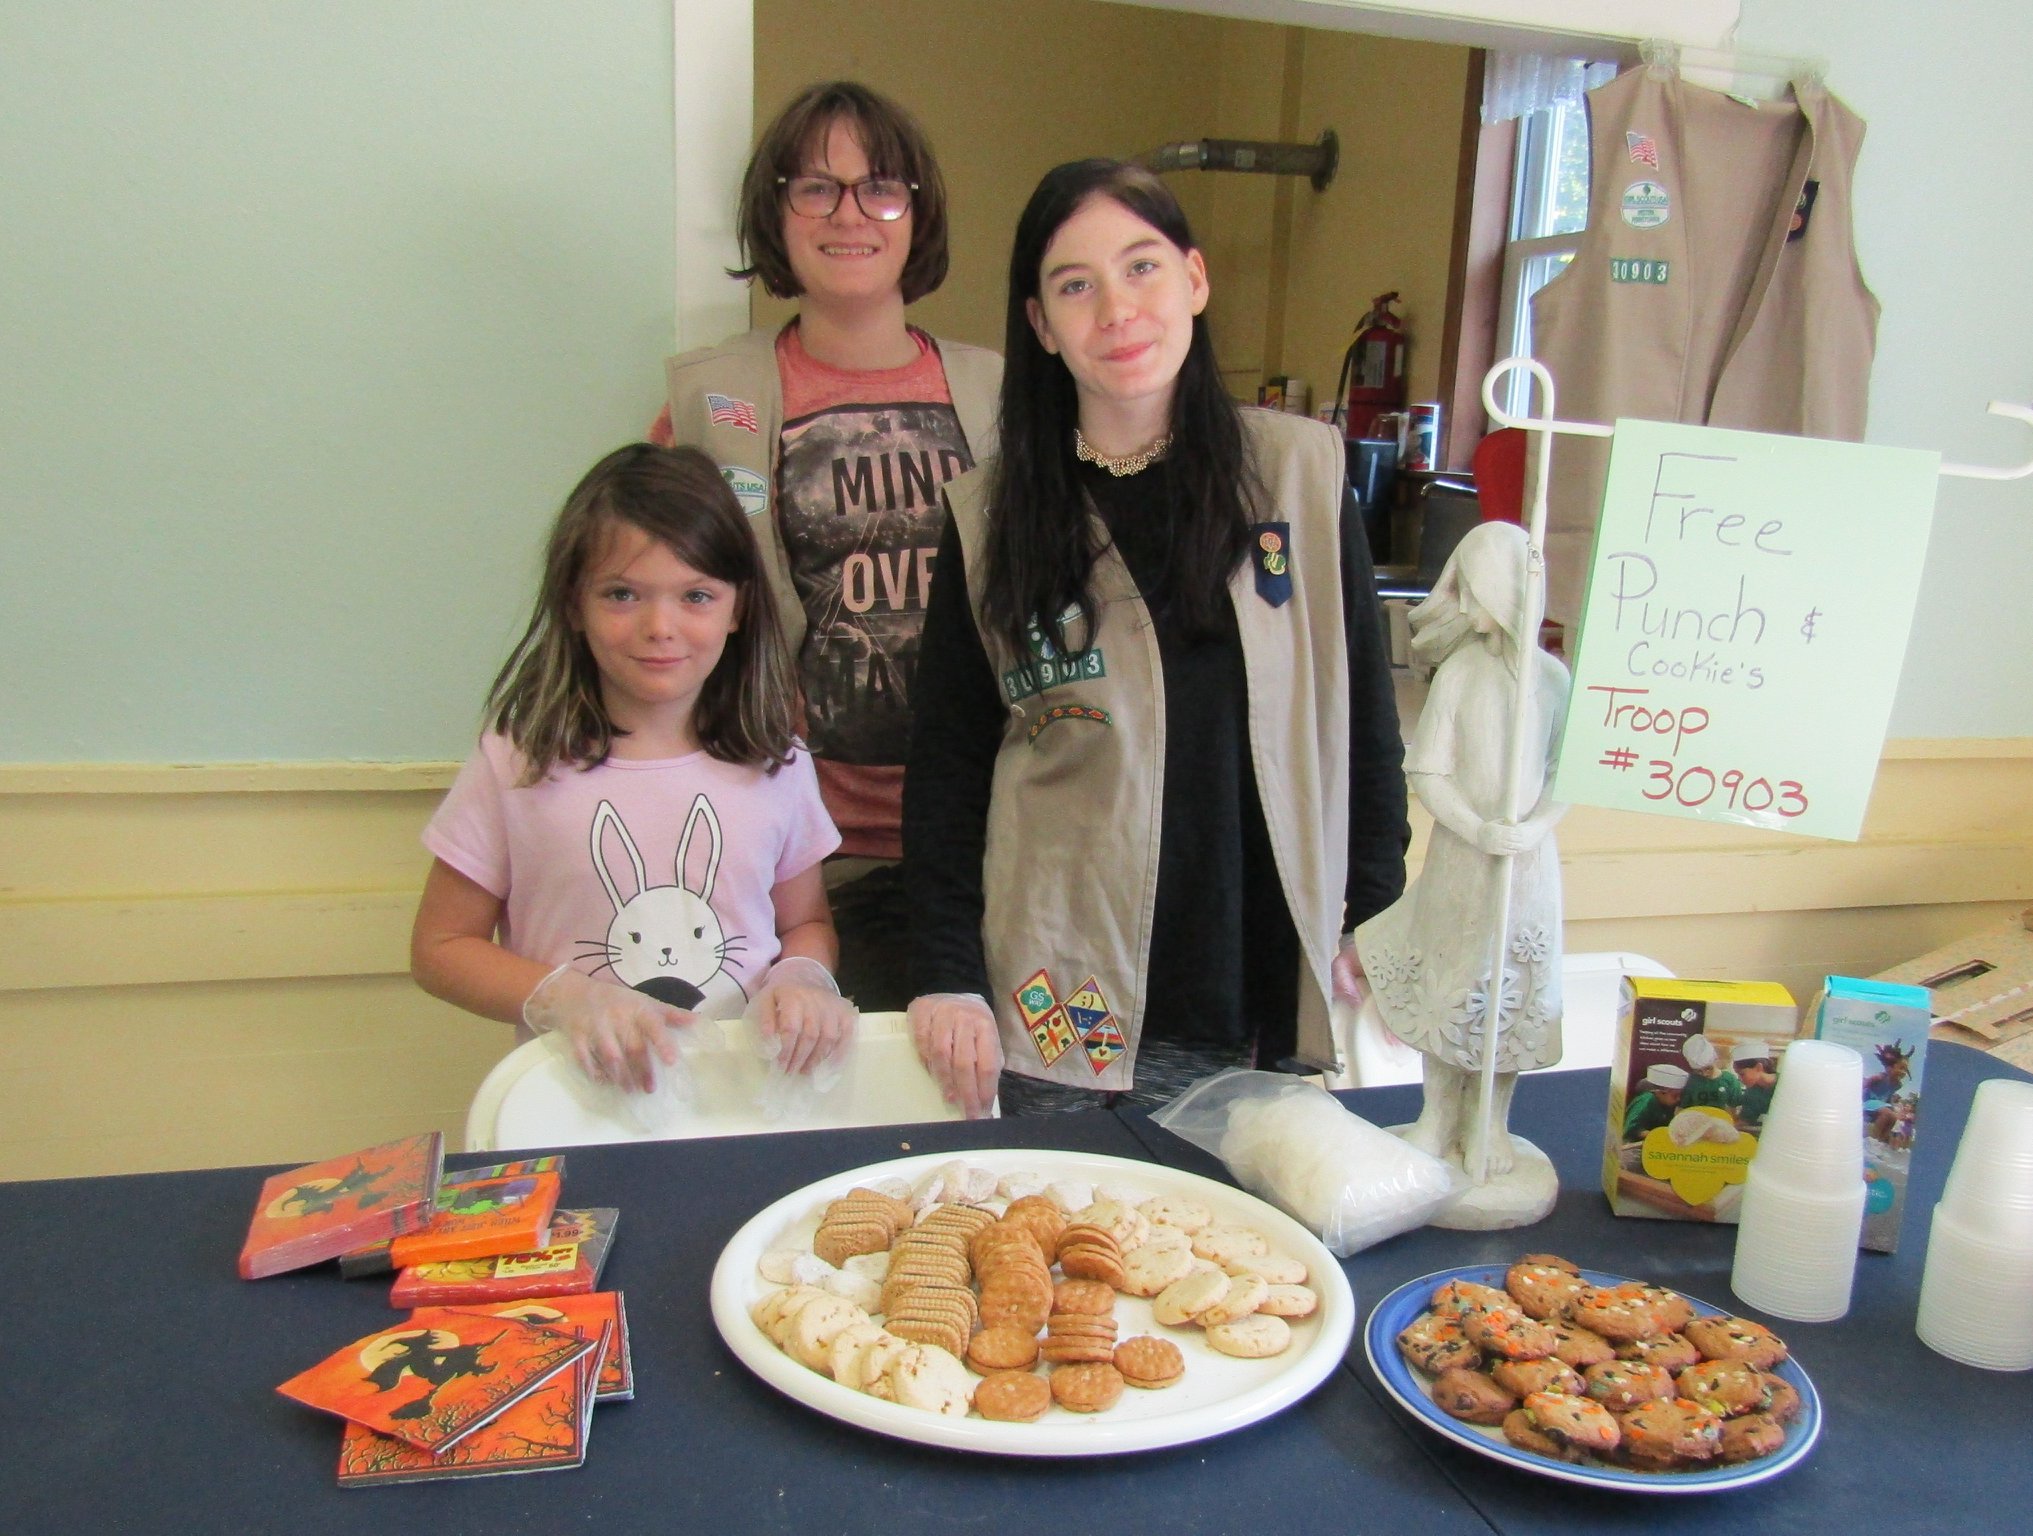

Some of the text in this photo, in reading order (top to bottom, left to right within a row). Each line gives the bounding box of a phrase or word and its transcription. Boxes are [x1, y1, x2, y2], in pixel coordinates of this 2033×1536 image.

[1612, 261, 1667, 281] 30903
[1645, 451, 1793, 555] Free
[1607, 551, 1767, 645] Punch
[1587, 685, 1710, 757] Troop
[1642, 1016, 1656, 1026] girl
[1648, 1150, 1750, 1166] savannah smiles
